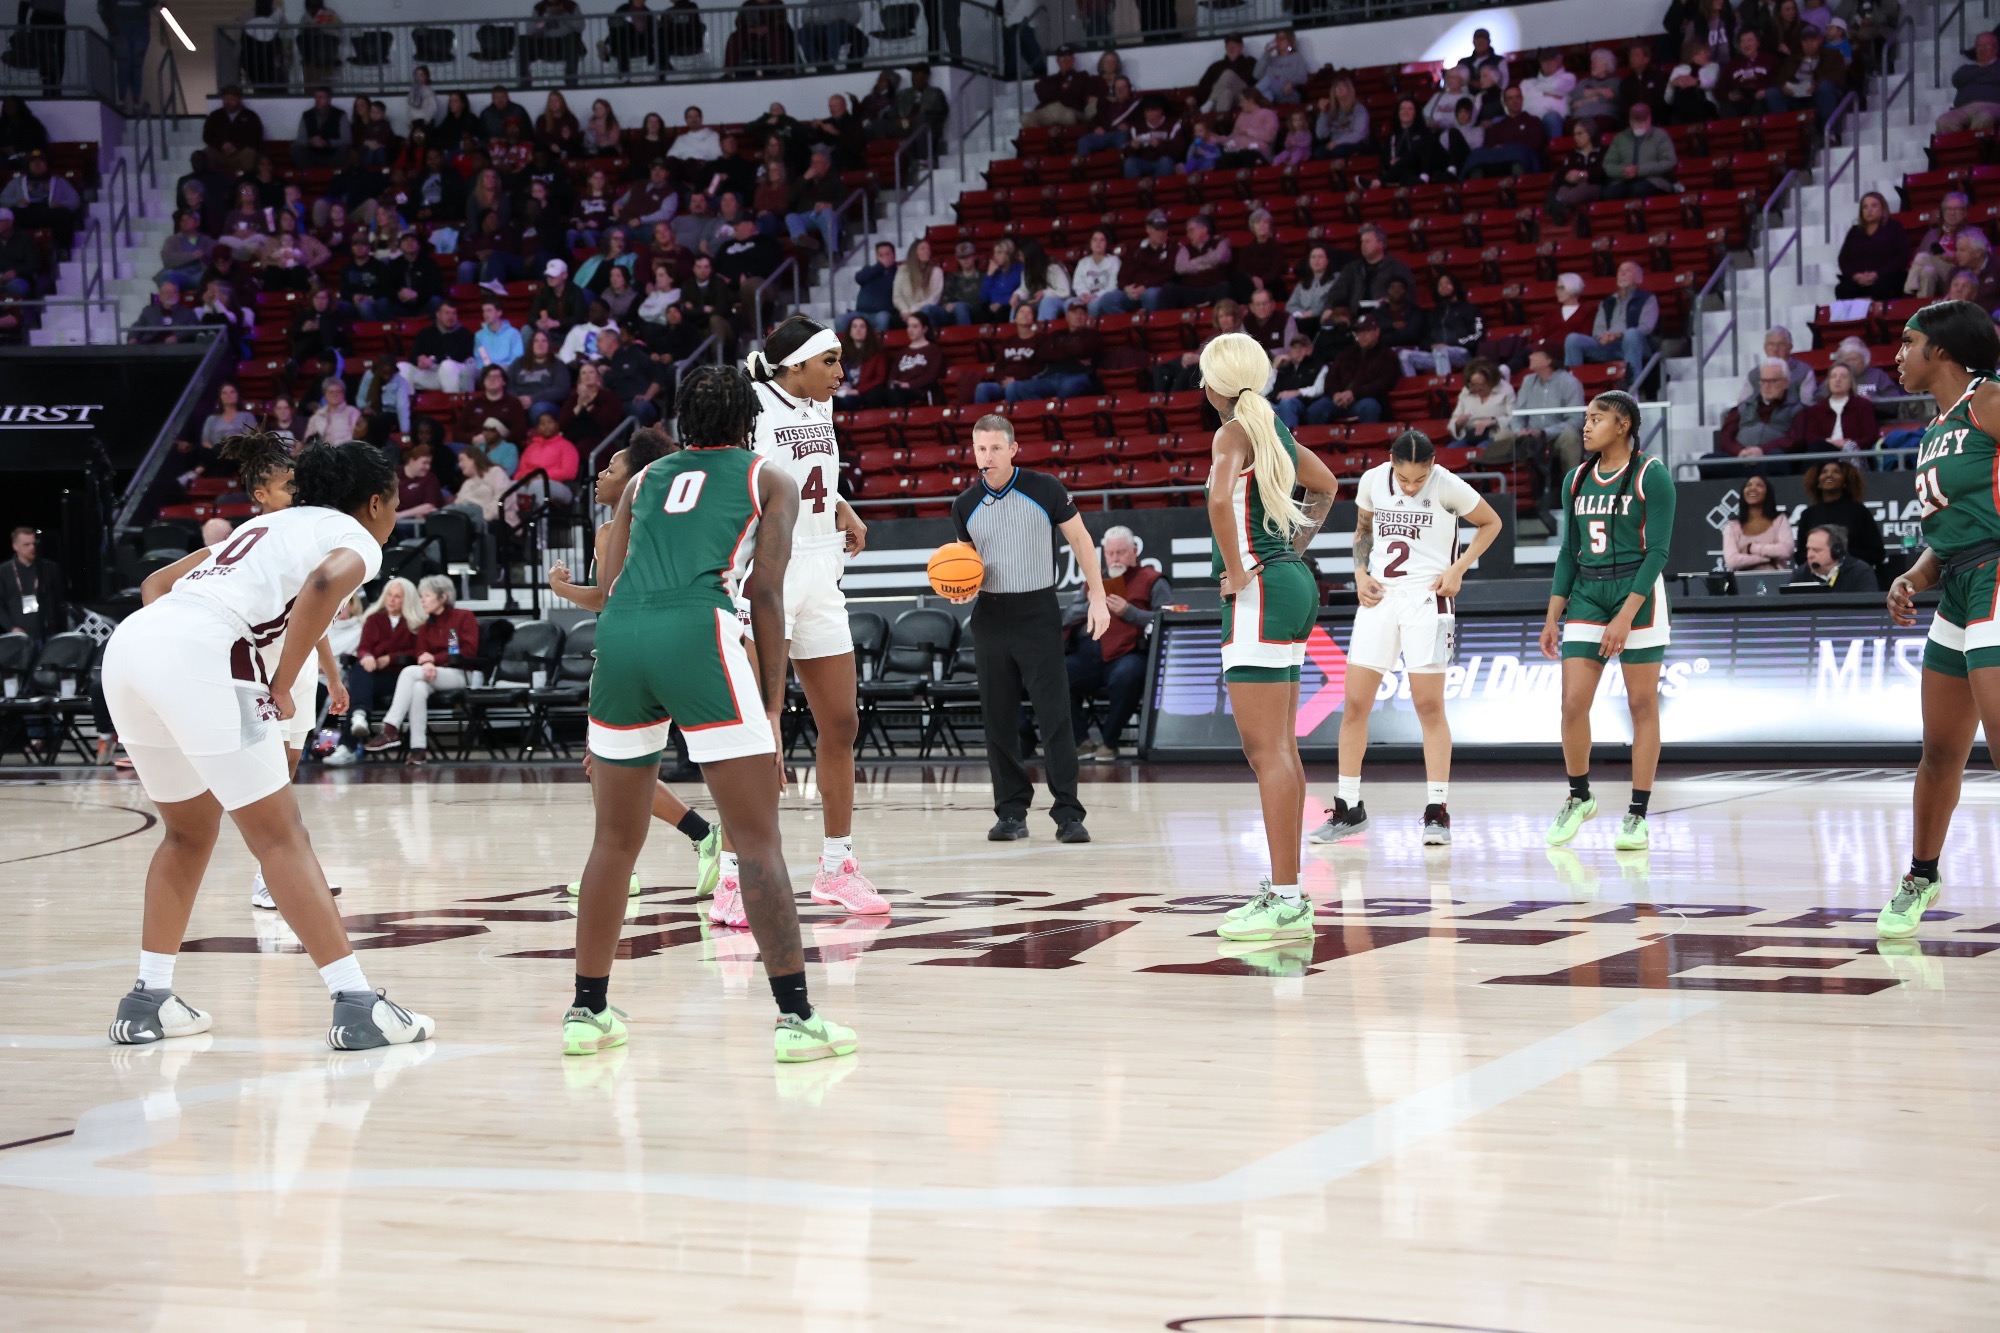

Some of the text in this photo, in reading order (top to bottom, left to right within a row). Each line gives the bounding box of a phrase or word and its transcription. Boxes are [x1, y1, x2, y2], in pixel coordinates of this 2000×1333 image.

[0, 404, 104, 422] IRST
[800, 441, 831, 454] STATE
[1916, 428, 1970, 470] ALLEY
[663, 469, 707, 515] 0
[801, 465, 828, 514] 4
[1915, 466, 1949, 520] 21
[1374, 510, 1434, 526] MISSISSIPPI
[1383, 525, 1414, 538] STATE
[1883, 522, 1922, 538] FUT
[215, 526, 270, 566] 0
[1588, 520, 1607, 555] 5
[1383, 540, 1411, 578] 2
[940, 583, 978, 595] Wilson
[1375, 655, 1693, 701] Stel Dynmcs
[1815, 638, 1926, 706] MIS
